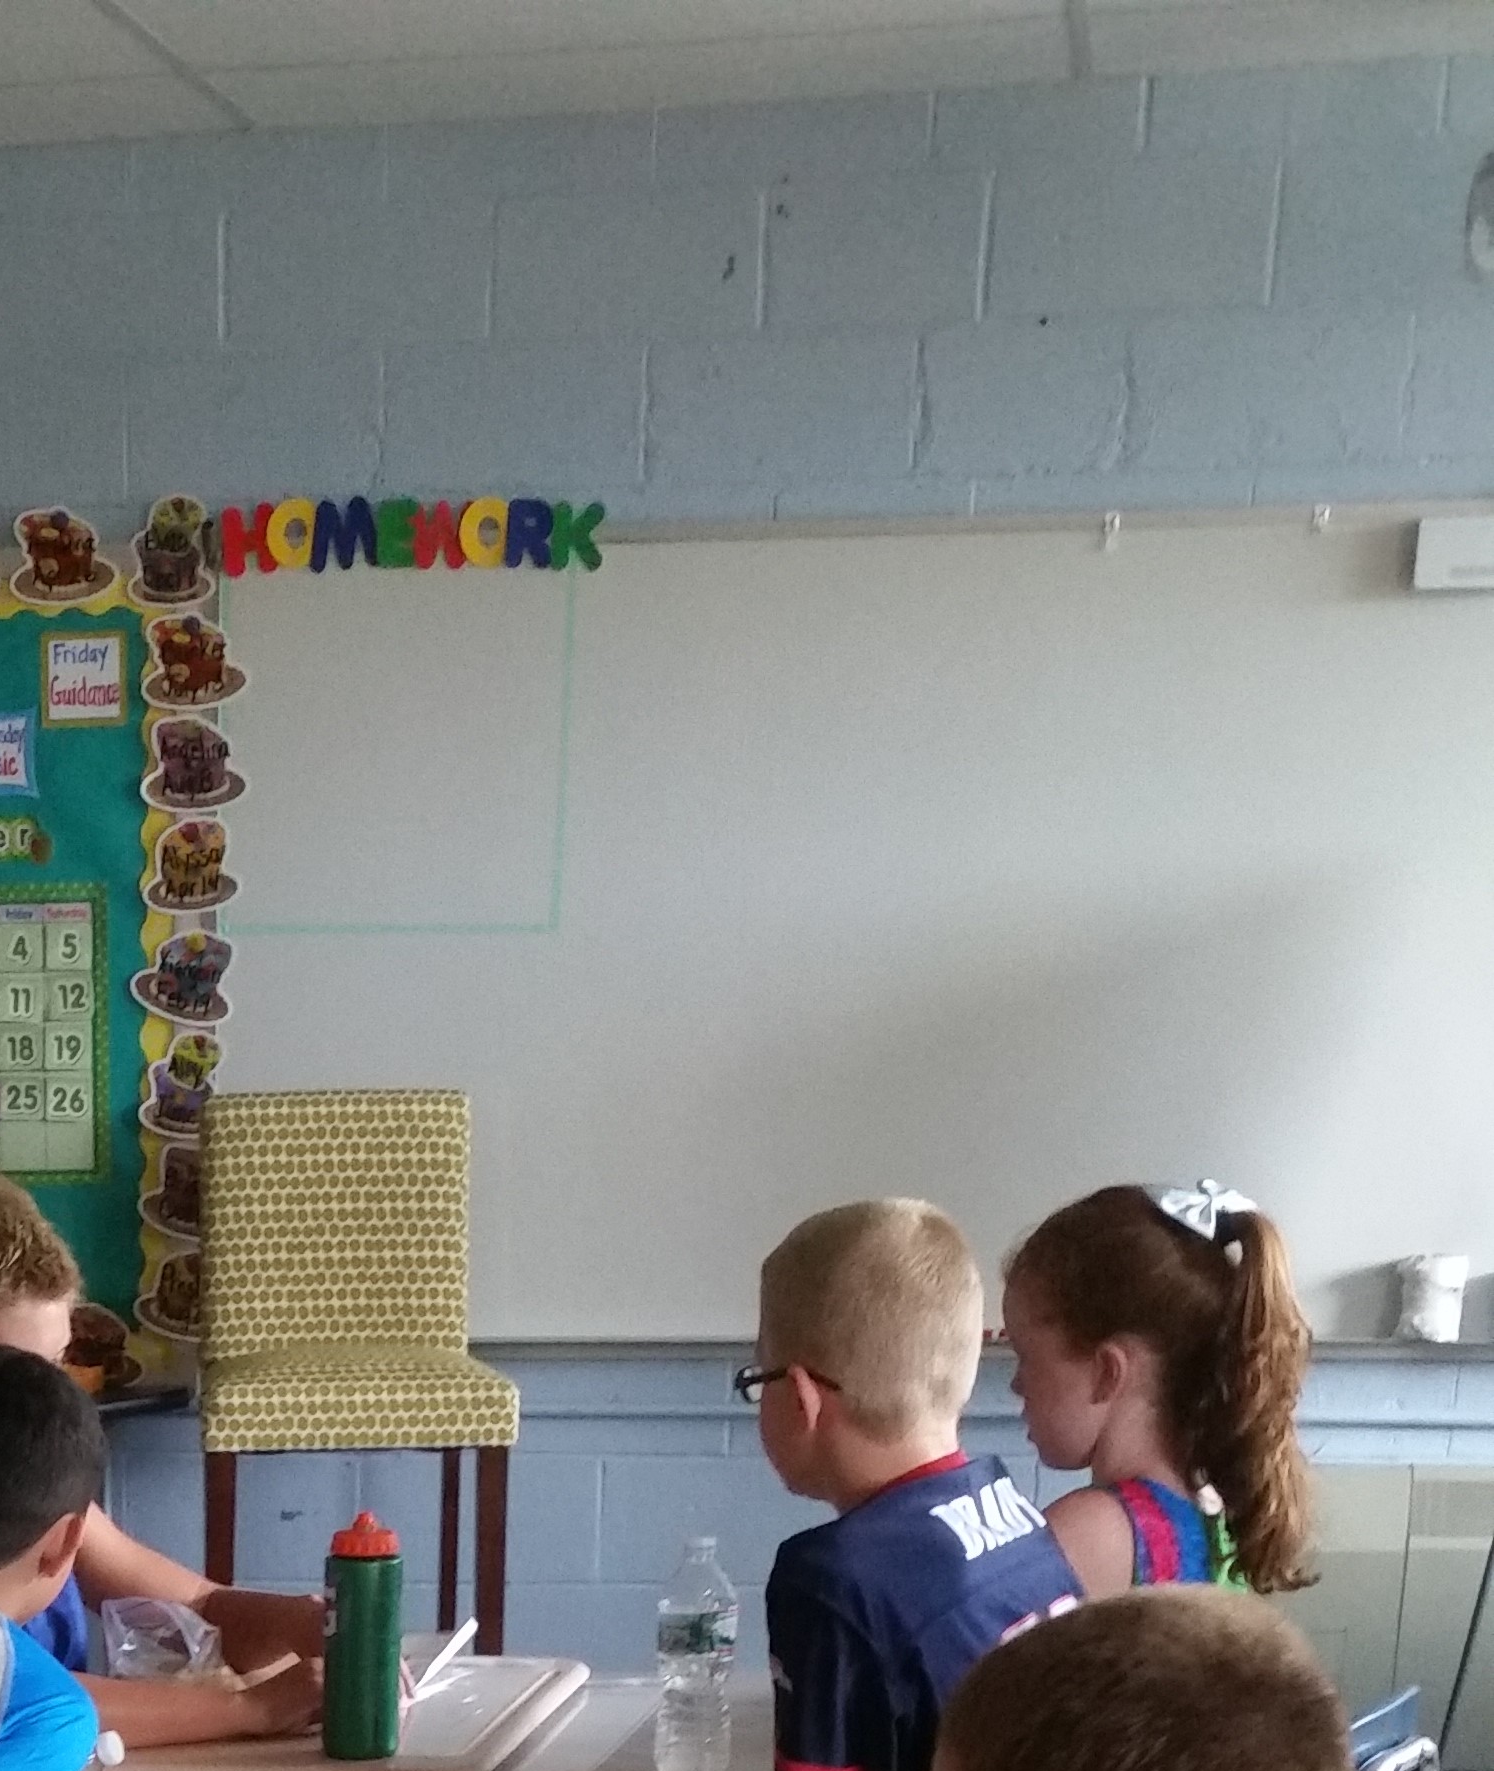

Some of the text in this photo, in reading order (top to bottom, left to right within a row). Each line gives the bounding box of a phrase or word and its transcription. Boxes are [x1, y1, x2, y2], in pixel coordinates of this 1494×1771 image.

[221, 495, 605, 577] HOMEWORK
[52, 643, 109, 672] Friday
[50, 677, 121, 707] Guidance
[11, 935, 29, 961] 4
[62, 933, 77, 959] 5
[10, 988, 31, 1014] 11
[57, 983, 86, 1010] 12
[7, 1036, 34, 1062] 18
[55, 1035, 81, 1061] 19
[6, 1085, 38, 1110] 25
[52, 1087, 84, 1112] 26
